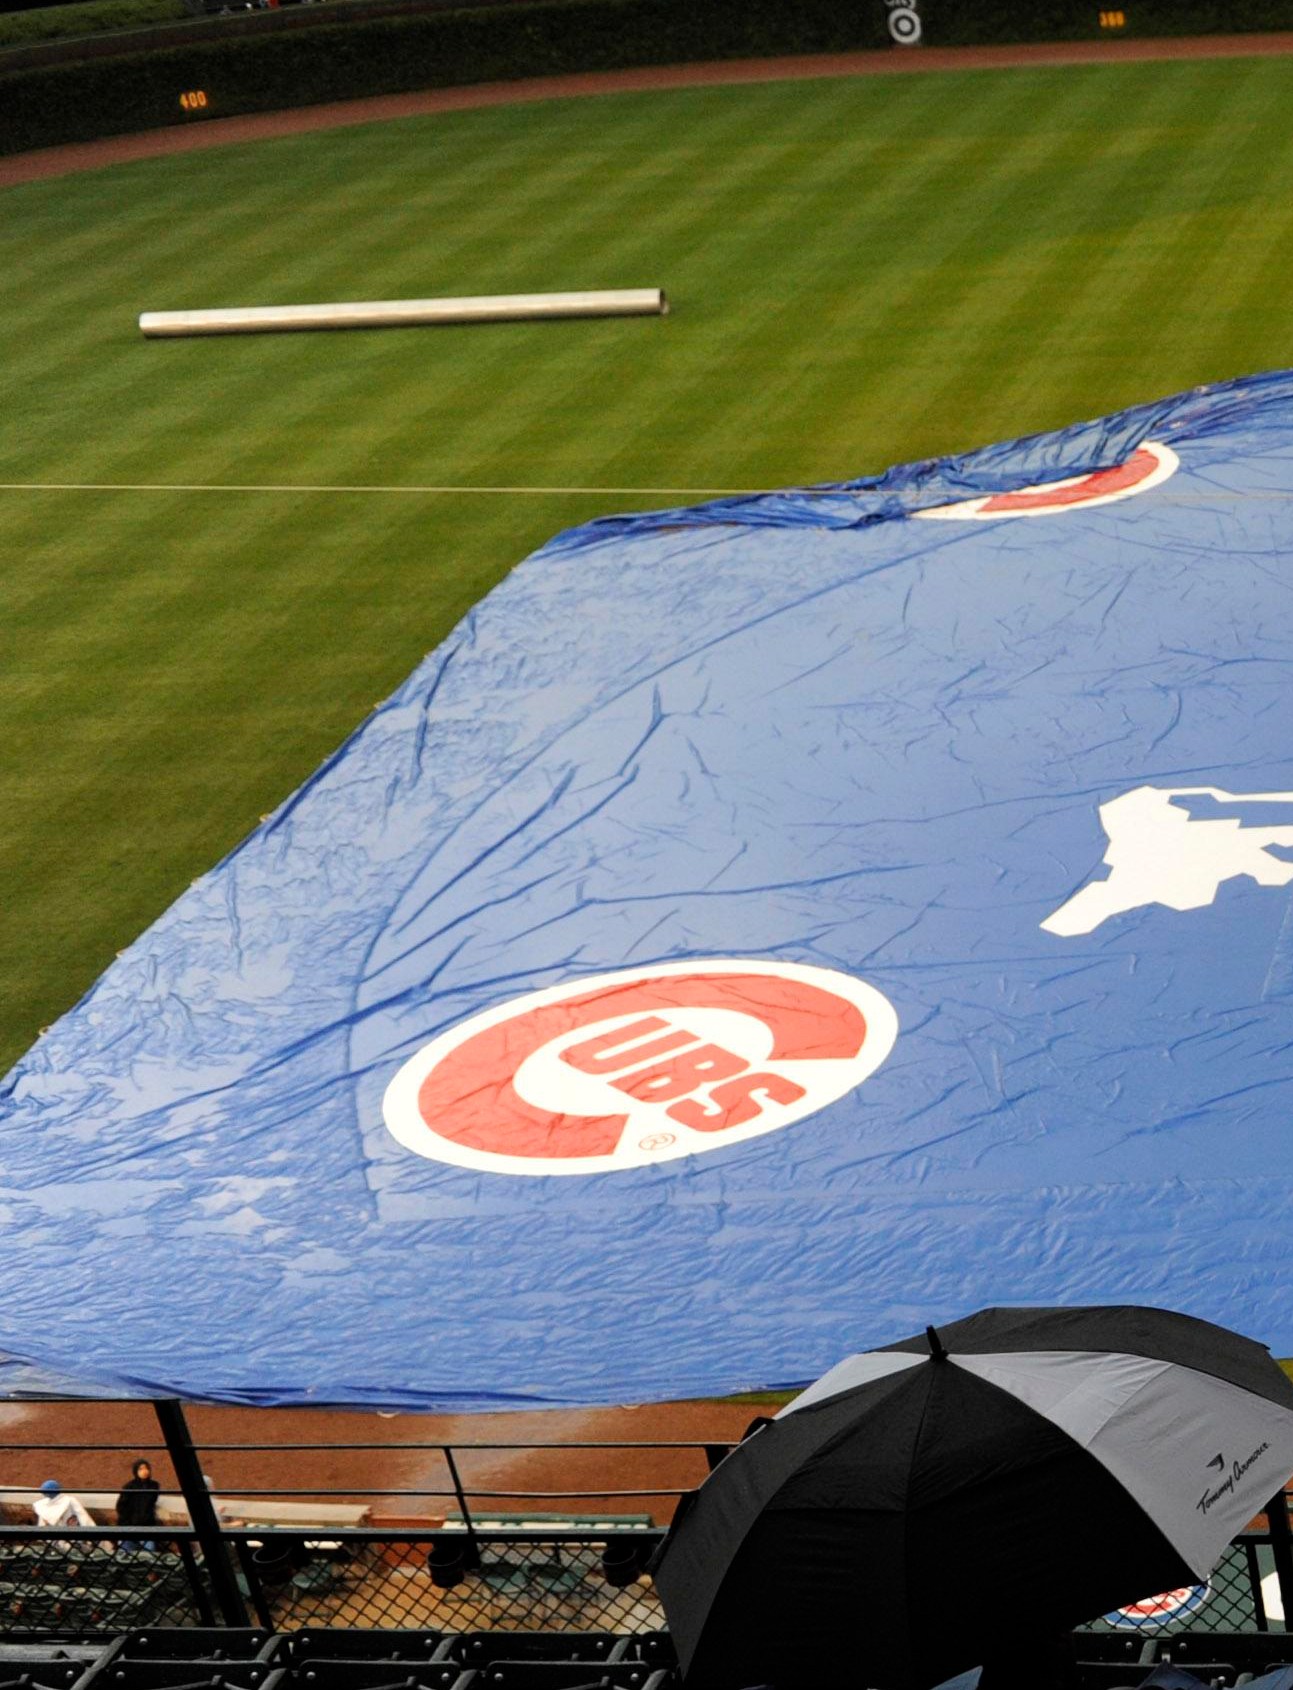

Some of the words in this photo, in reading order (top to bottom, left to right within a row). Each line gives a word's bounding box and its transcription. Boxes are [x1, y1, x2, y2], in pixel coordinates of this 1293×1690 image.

[180, 90, 207, 109] 400
[418, 973, 868, 1159] CUBS
[1196, 1475, 1233, 1515] Tommy
